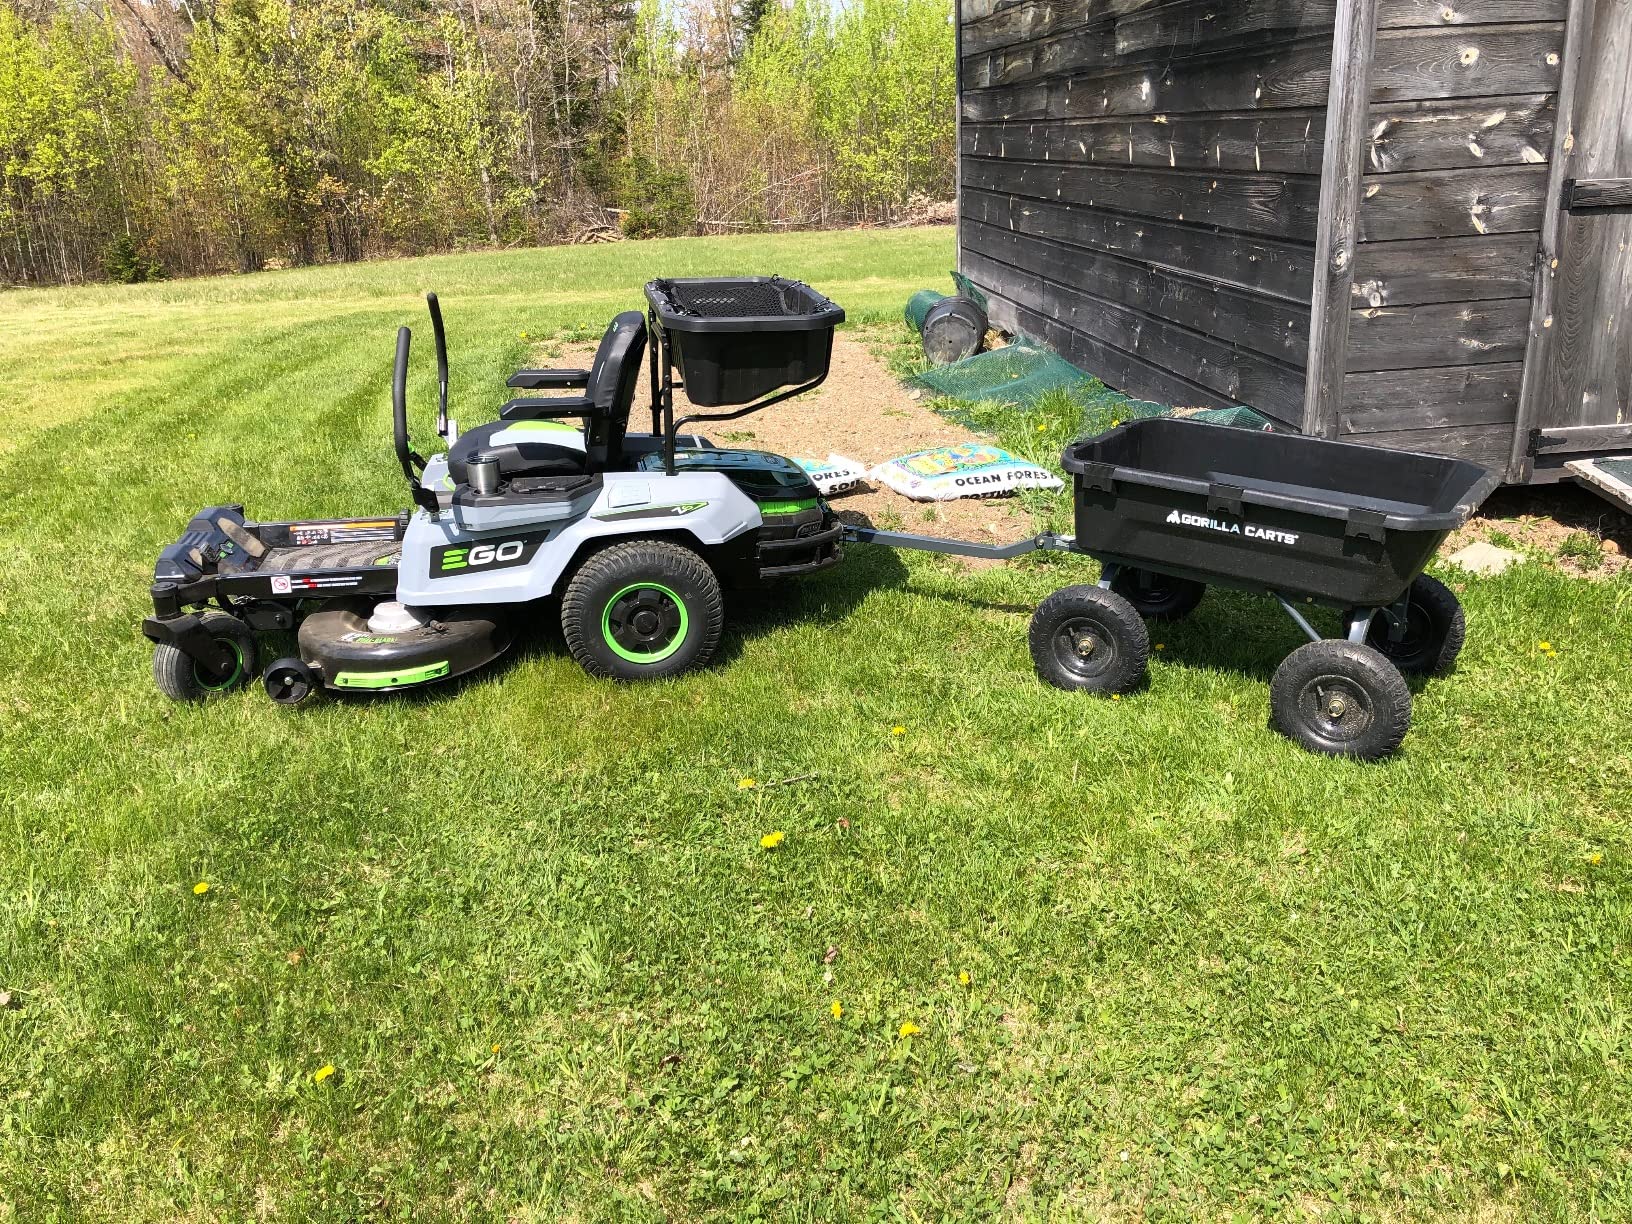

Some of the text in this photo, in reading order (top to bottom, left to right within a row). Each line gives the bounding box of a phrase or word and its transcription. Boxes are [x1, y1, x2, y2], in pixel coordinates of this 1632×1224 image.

[955, 473, 1001, 487] OCEAN
[1181, 513, 1297, 545] GORILLA CARTS
[441, 540, 524, 570] EGO
